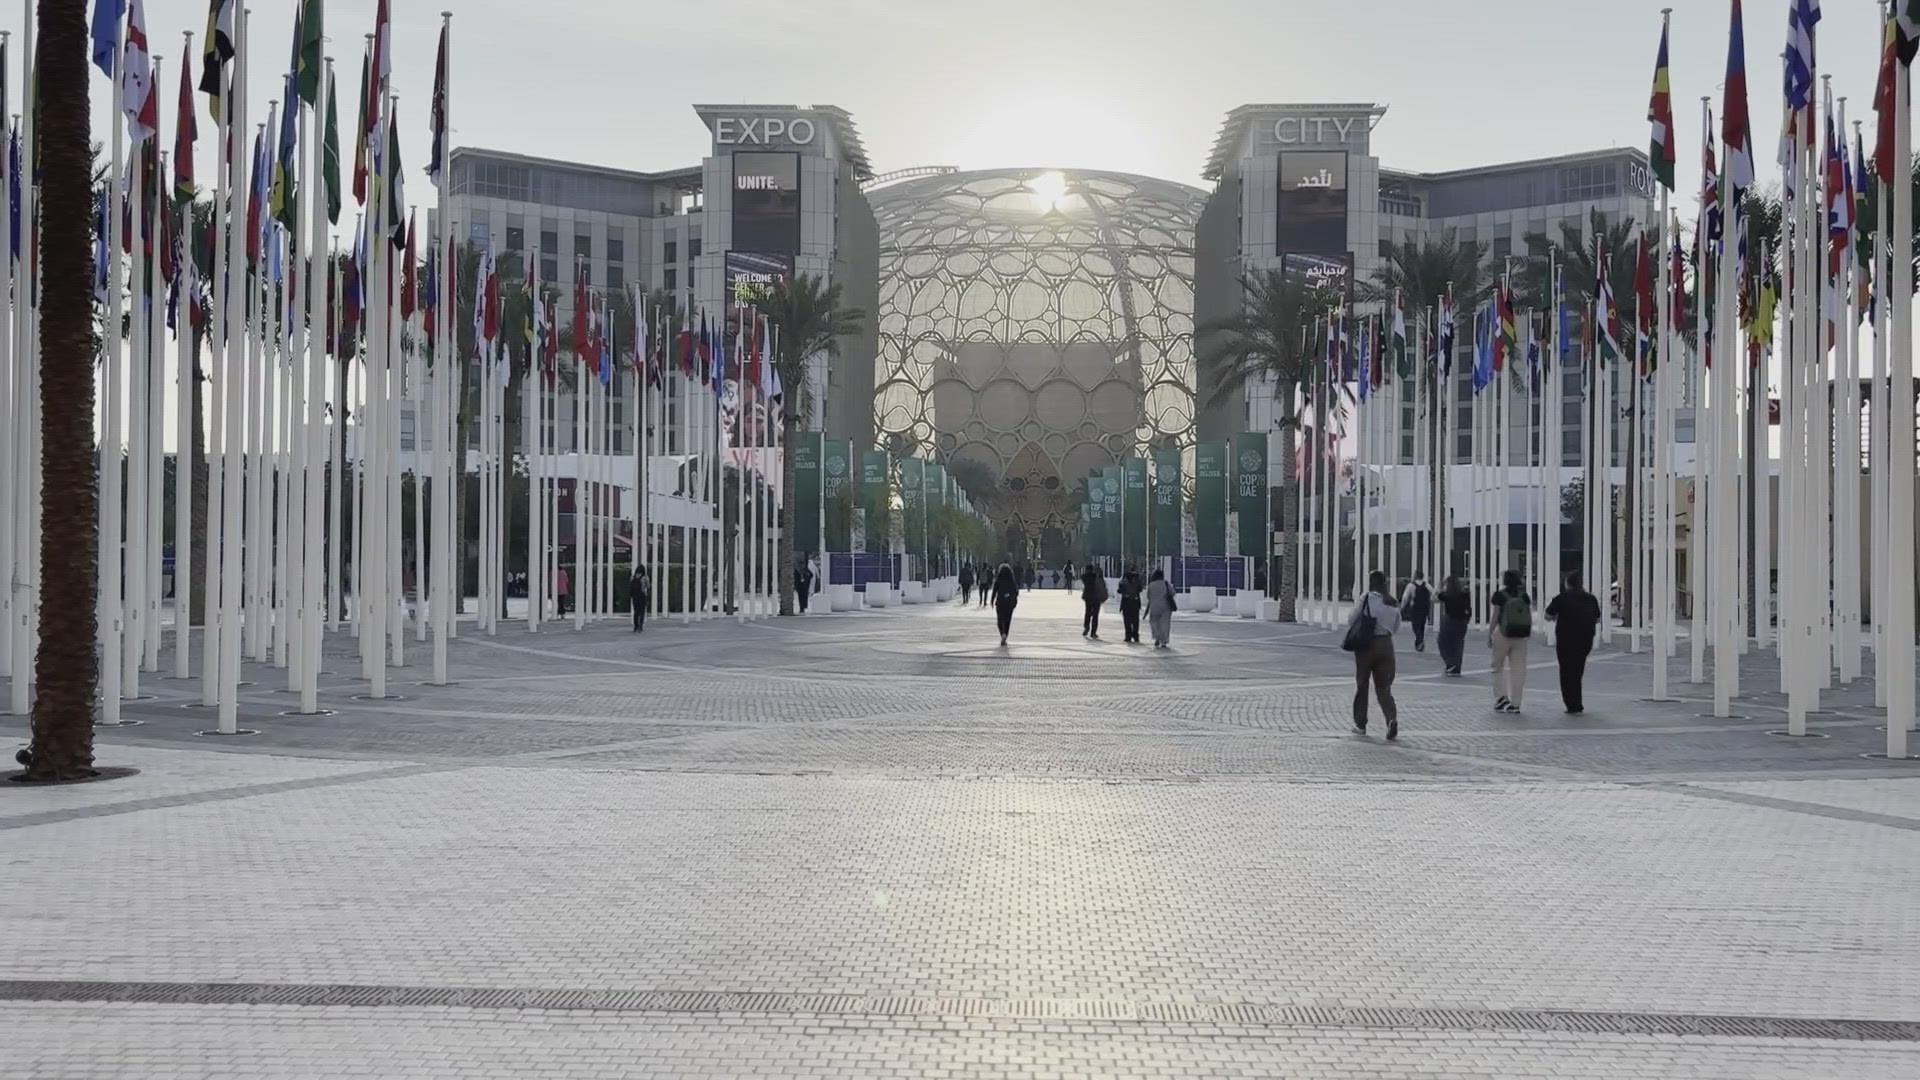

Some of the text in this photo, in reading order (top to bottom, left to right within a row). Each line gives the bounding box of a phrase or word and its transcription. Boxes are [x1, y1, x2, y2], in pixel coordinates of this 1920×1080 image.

[716, 118, 815, 145] EXPO
[1274, 117, 1354, 143] CITY
[737, 175, 779, 190] UNITE.
[734, 273, 772, 283] WELCOME
[734, 283, 765, 292] GEER
[825, 477, 848, 488] COP
[1239, 474, 1265, 486] COP28
[1239, 485, 1257, 497] UAE
[1158, 495, 1172, 505] UAE
